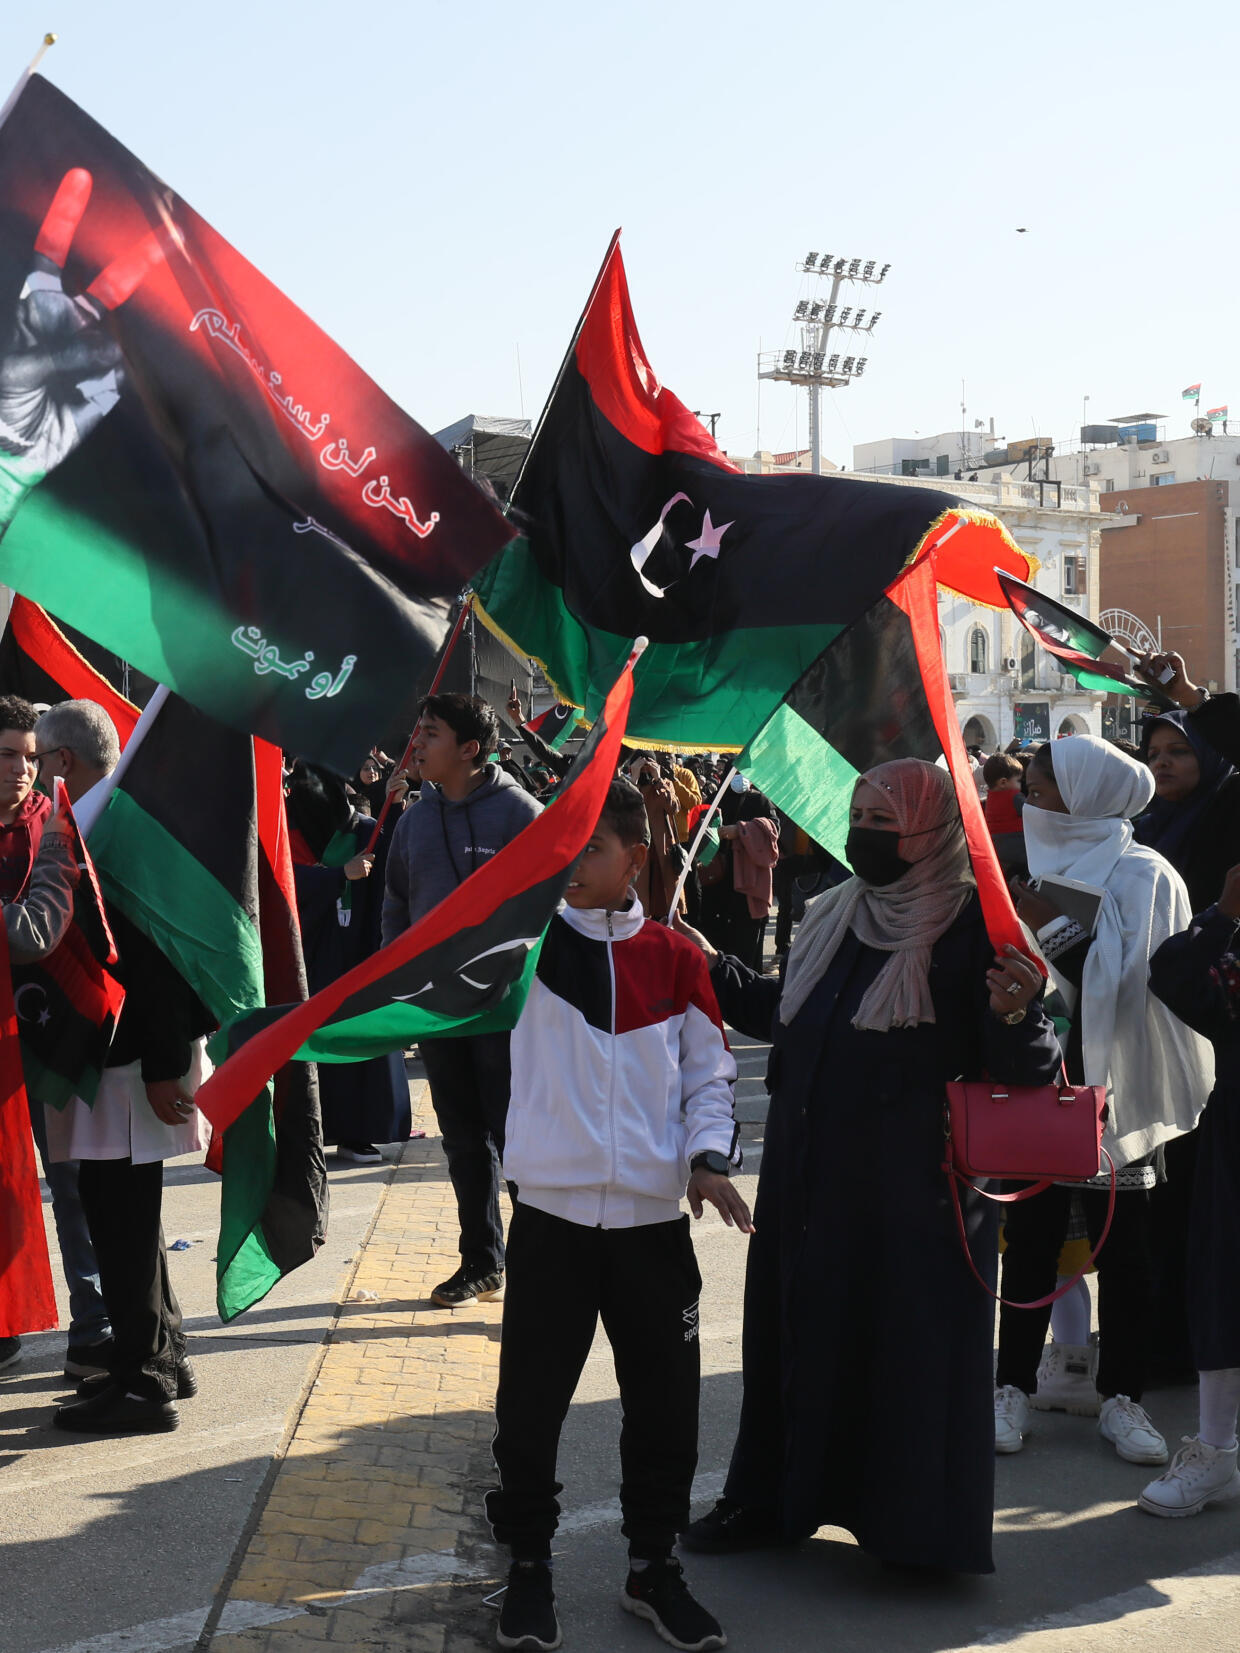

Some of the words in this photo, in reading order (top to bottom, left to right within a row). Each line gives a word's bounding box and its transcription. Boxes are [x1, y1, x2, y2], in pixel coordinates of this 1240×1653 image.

[189, 308, 331, 441] نستسلم
[320, 438, 376, 477] لن
[362, 476, 440, 539] نحن
[231, 625, 315, 680] نموت
[305, 655, 358, 700] أو
